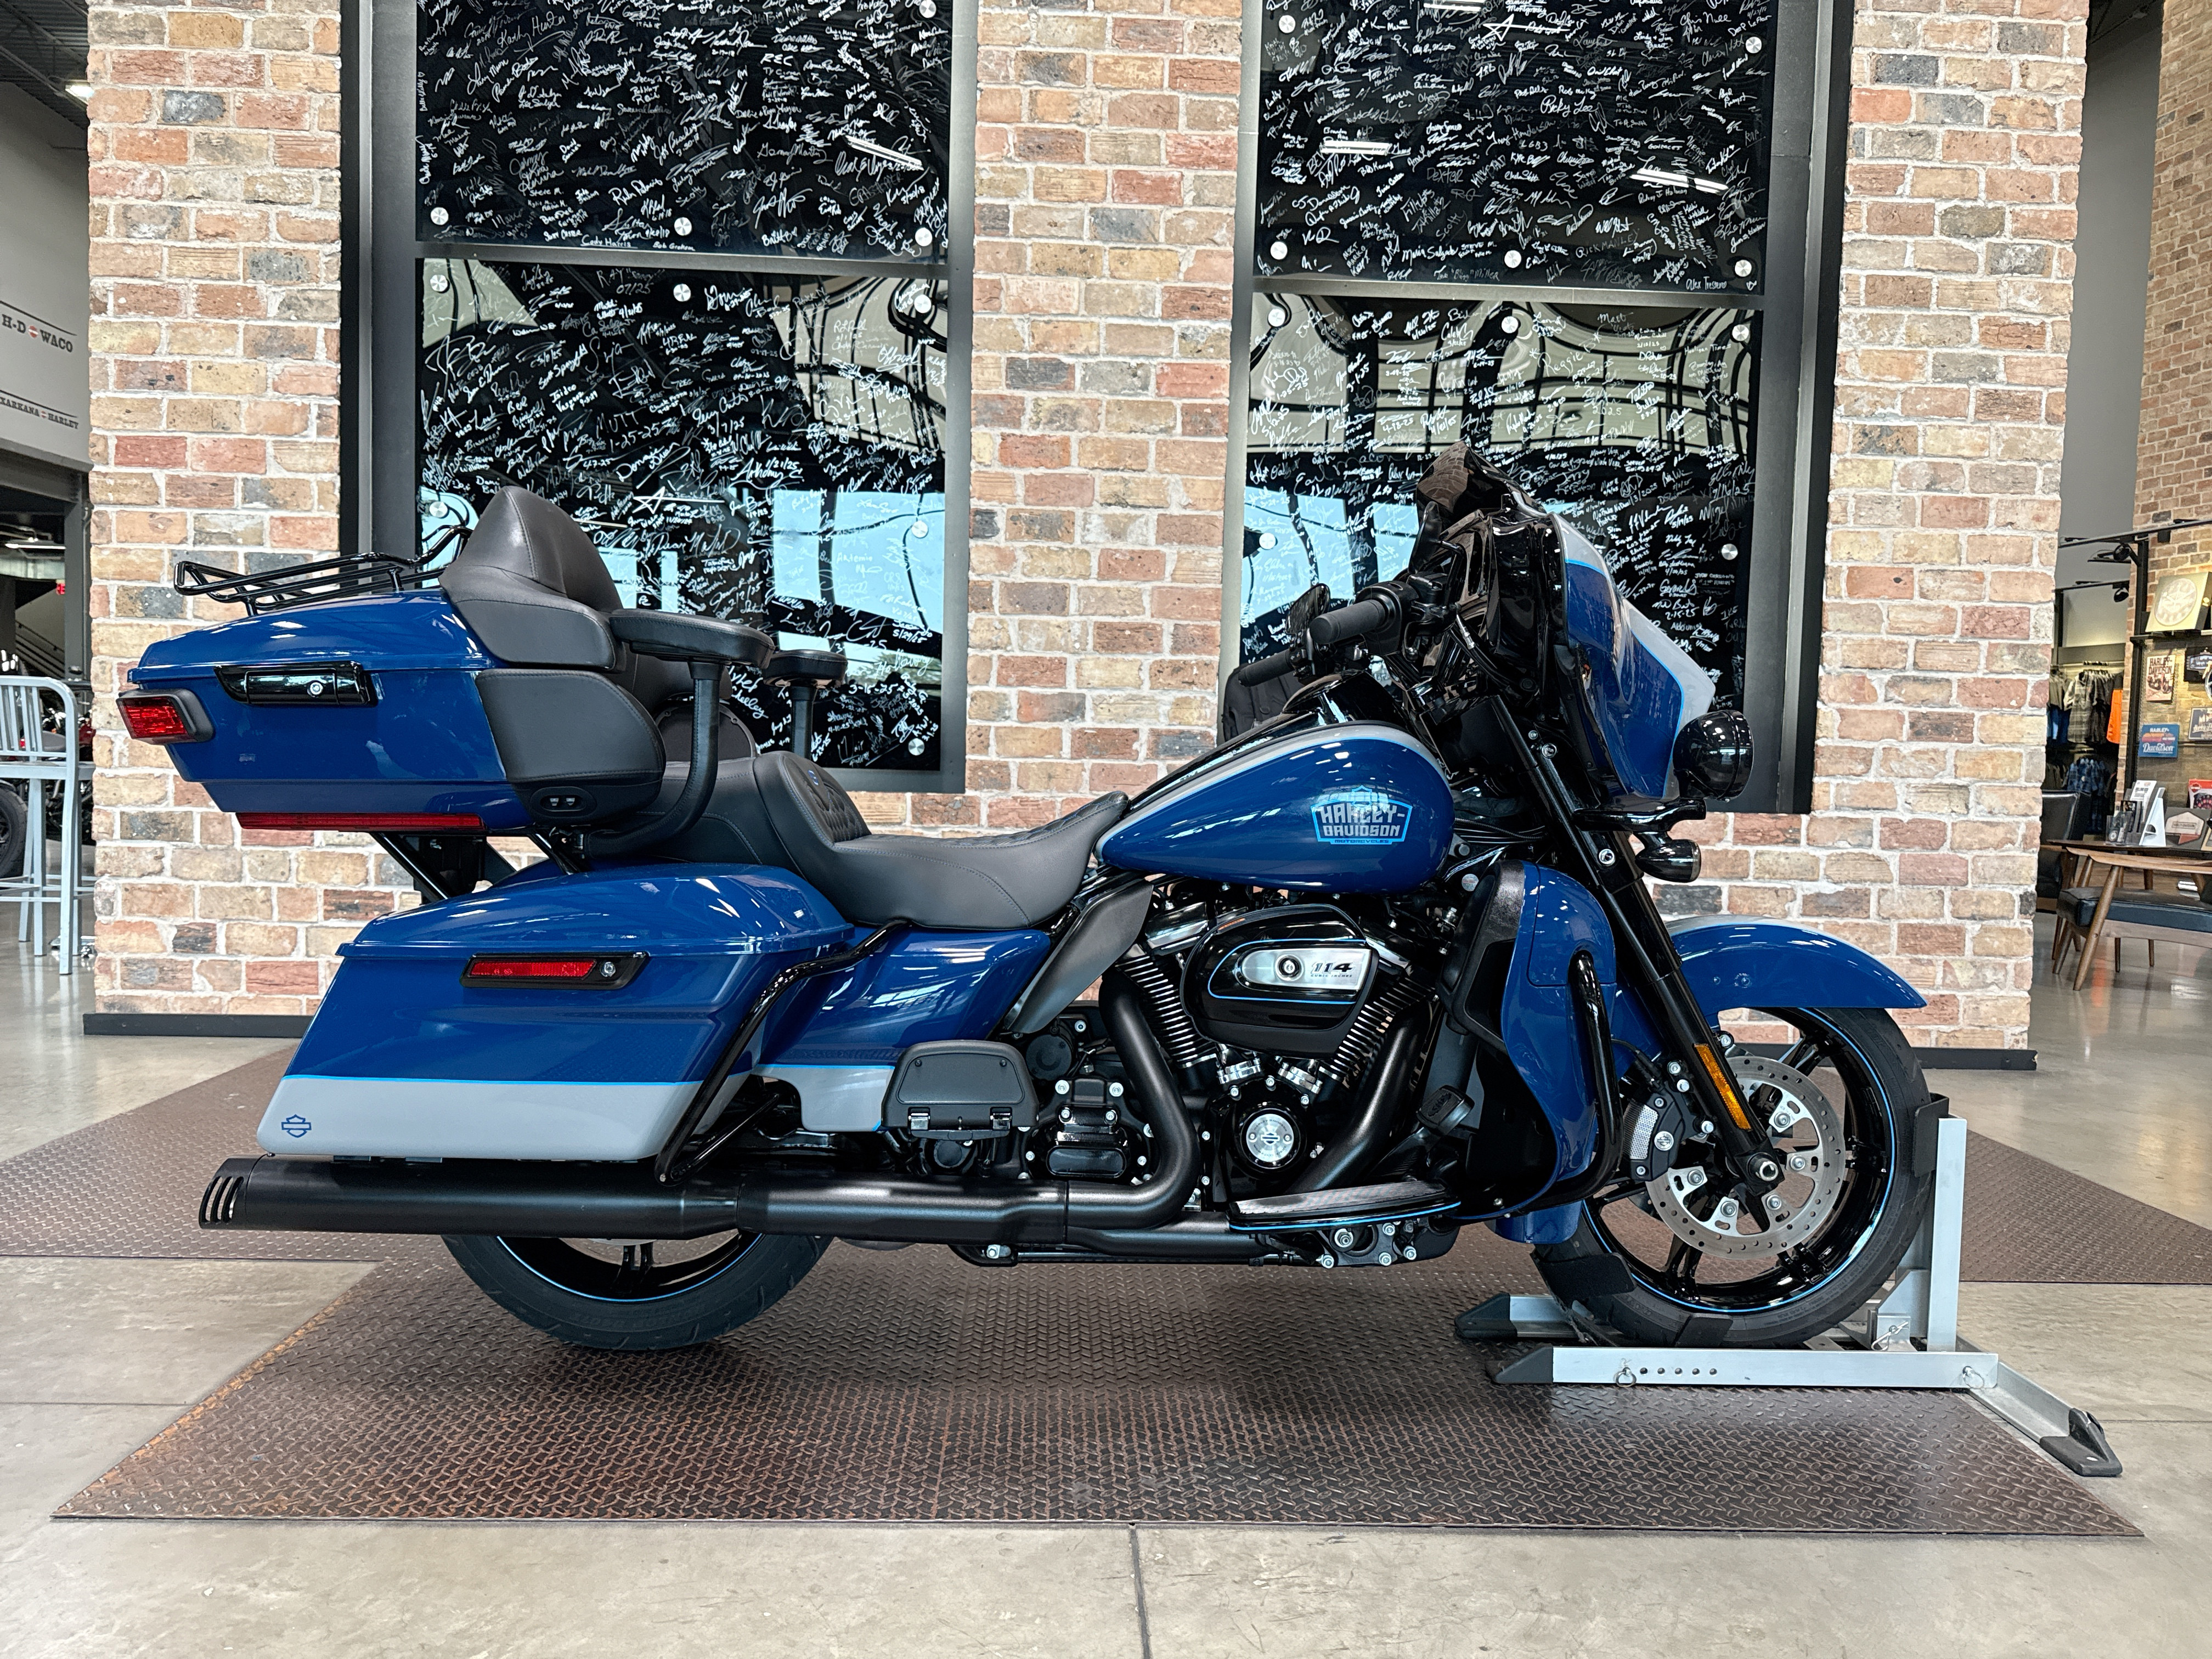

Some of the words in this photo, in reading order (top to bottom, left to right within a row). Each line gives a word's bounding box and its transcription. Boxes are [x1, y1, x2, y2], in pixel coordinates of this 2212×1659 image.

[1505, 5, 1547, 19] Montgomery
[760, 53, 793, 66] REC
[1541, 94, 1571, 118] Ricky
[1573, 95, 1599, 115] Lee
[582, 234, 603, 246] Cody
[605, 238, 631, 247] Harris
[1, 313, 26, 334] H-D
[40, 329, 74, 353] WACO
[1684, 346, 1708, 356] Hooligan
[1537, 351, 1583, 379] Reggie
[48, 412, 78, 430] HARLEY
[2142, 742, 2174, 753] Davidson
[1320, 803, 1405, 823] HARLEY-
[1323, 825, 1401, 837] DAVIDSON
[1312, 962, 1353, 974] 114
